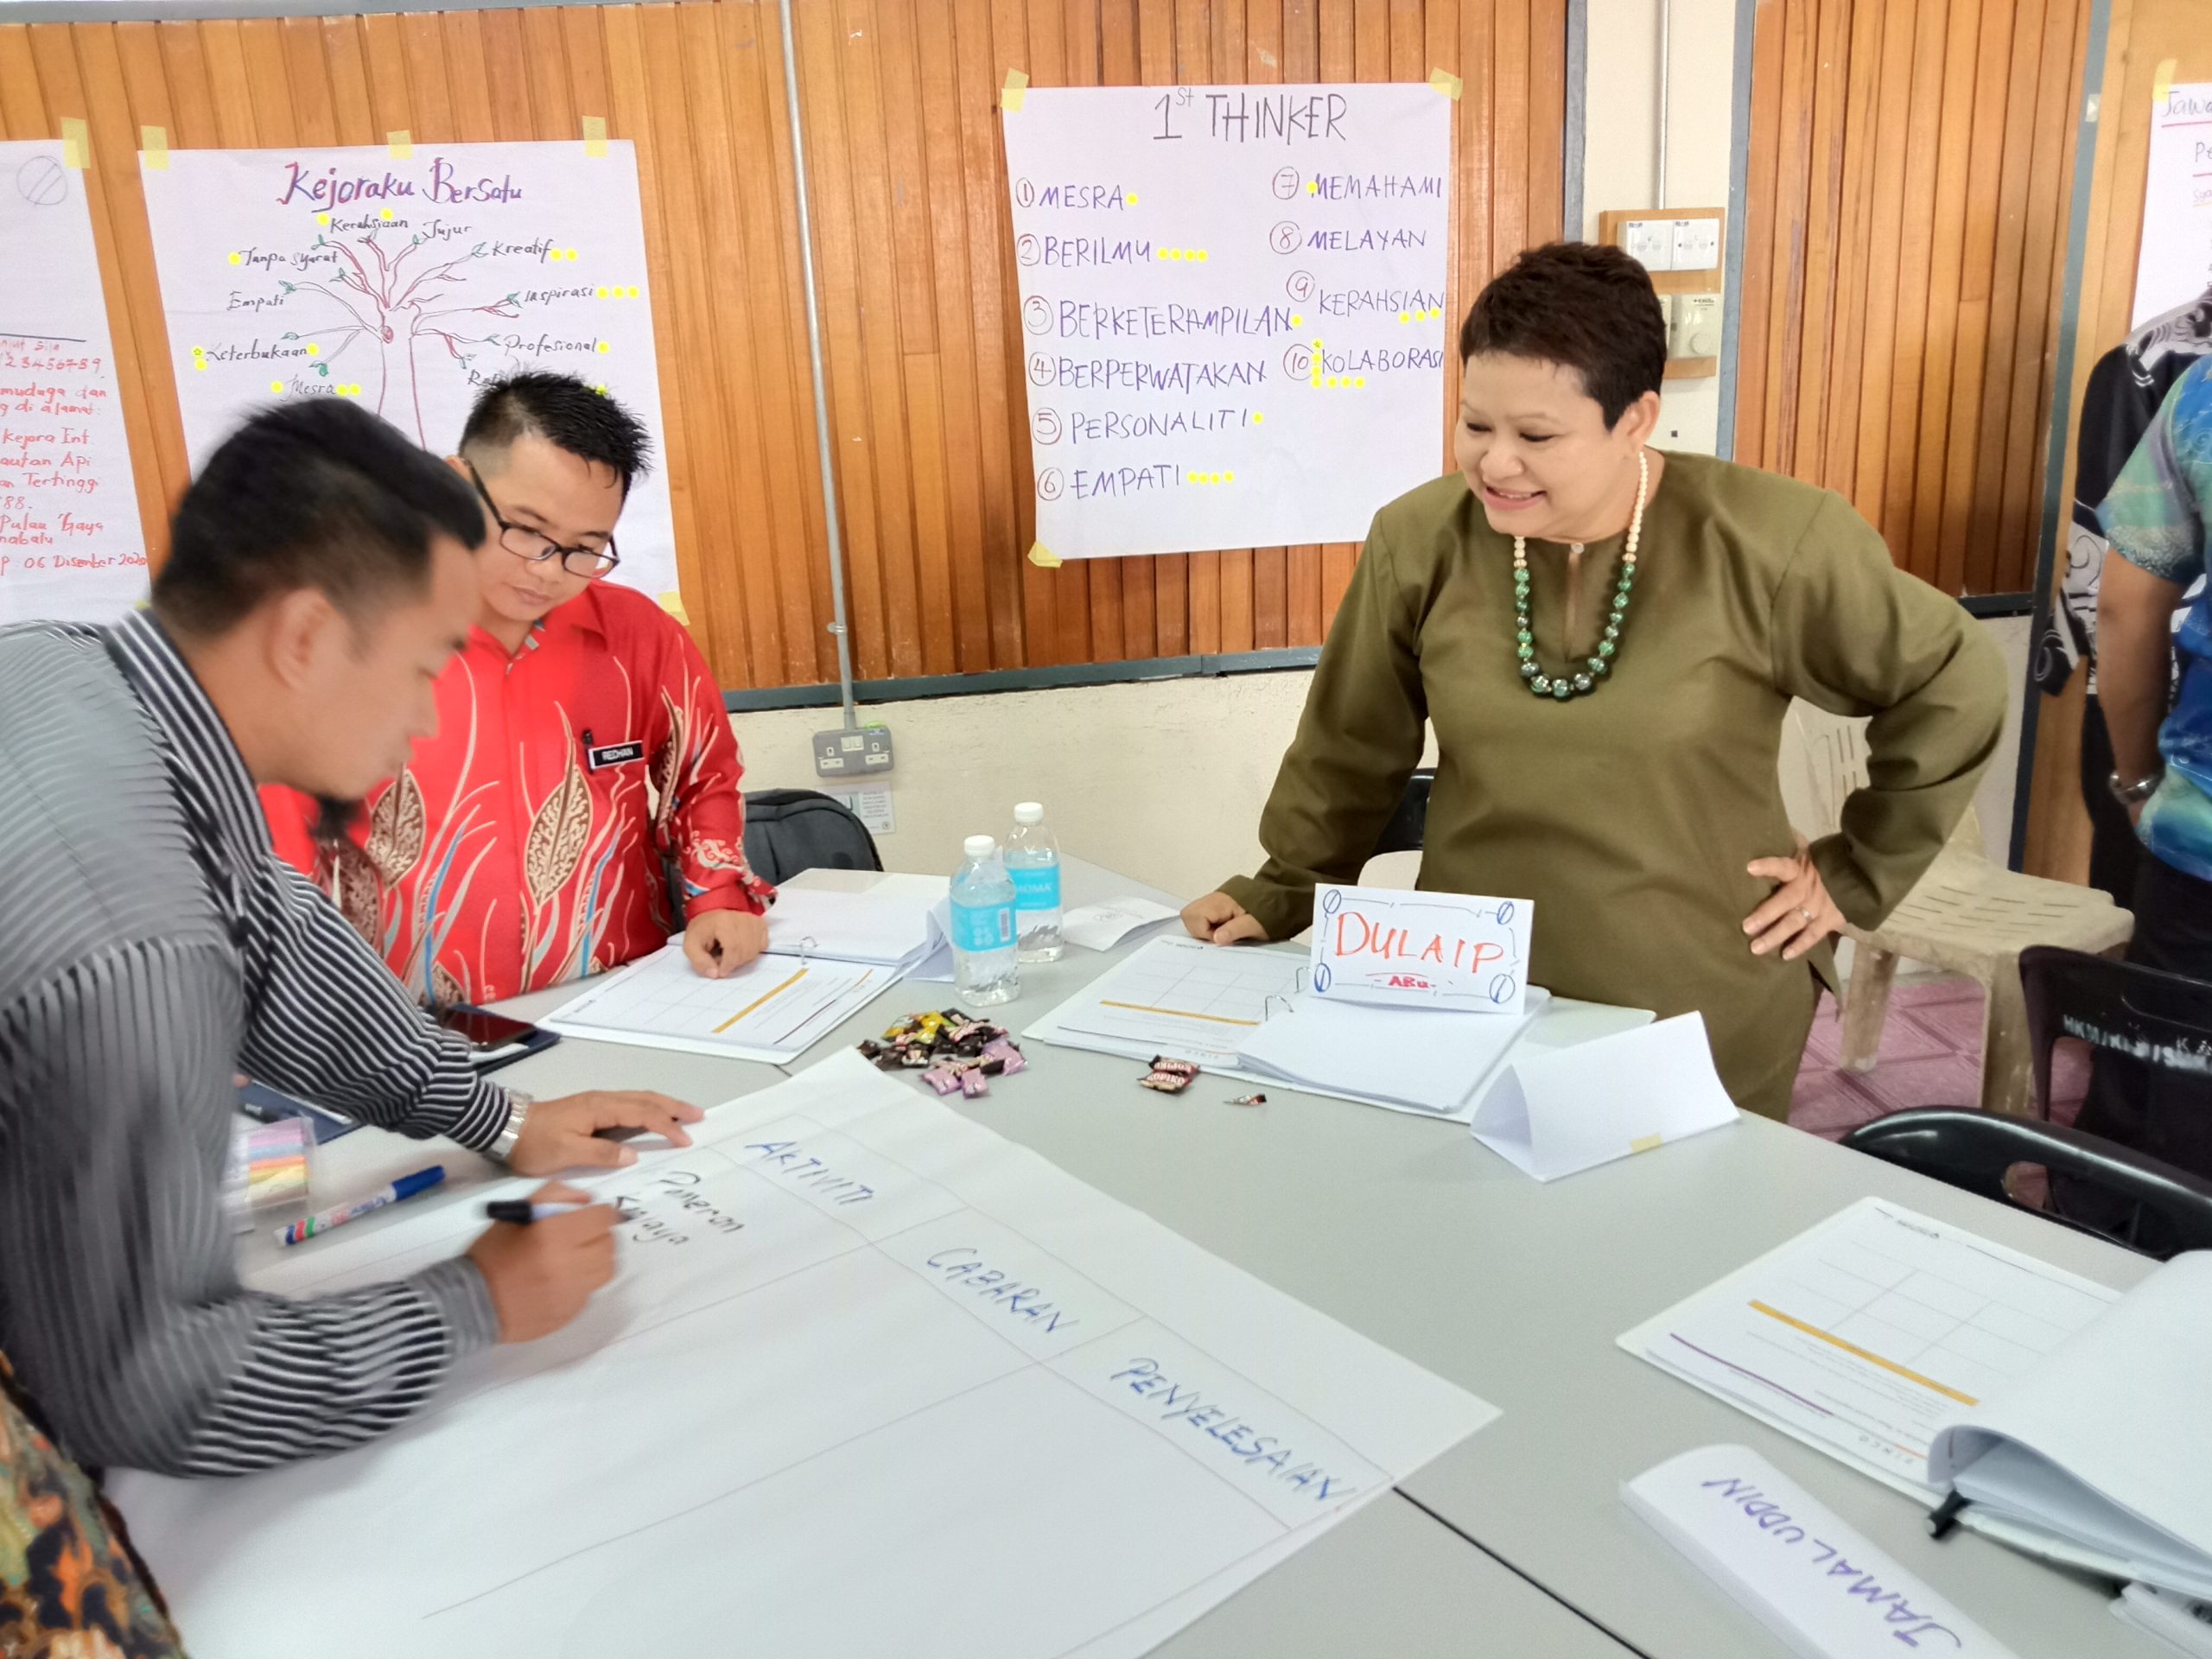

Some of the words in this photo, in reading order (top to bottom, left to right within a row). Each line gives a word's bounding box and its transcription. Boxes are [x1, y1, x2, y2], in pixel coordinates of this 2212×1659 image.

[1205, 92, 1347, 145] THINKER
[276, 162, 416, 213] Kejoraku
[1039, 184, 1124, 210] MESRA
[1312, 175, 1441, 200] MEMAHAMI
[422, 219, 472, 241] Jujur
[1307, 229, 1426, 251] MELAYAN
[238, 246, 286, 271] Tanpa
[1045, 236, 1151, 268] BERILMU
[226, 290, 284, 312] Empati
[524, 283, 594, 305] Inspirasi
[1319, 289, 1444, 316] KERAHSIAN
[1059, 300, 1294, 340] BERKETERAMPILAN
[206, 339, 307, 361] Keterbukaan
[504, 334, 597, 356] Profesional
[1058, 356, 1266, 394] BERPERWATAKAN
[1321, 347, 1443, 375] KOLABORASI
[280, 374, 336, 402] Mesra
[1072, 409, 1247, 443] PERSONALITI
[60, 451, 92, 474] Api
[1071, 465, 1179, 500] EMPATI
[1334, 912, 1503, 973] DULAIP
[745, 1141, 874, 1205] AKTIVITI
[927, 1248, 1080, 1334] CABARAN
[1110, 1357, 1357, 1501] PENYELESAIAN
